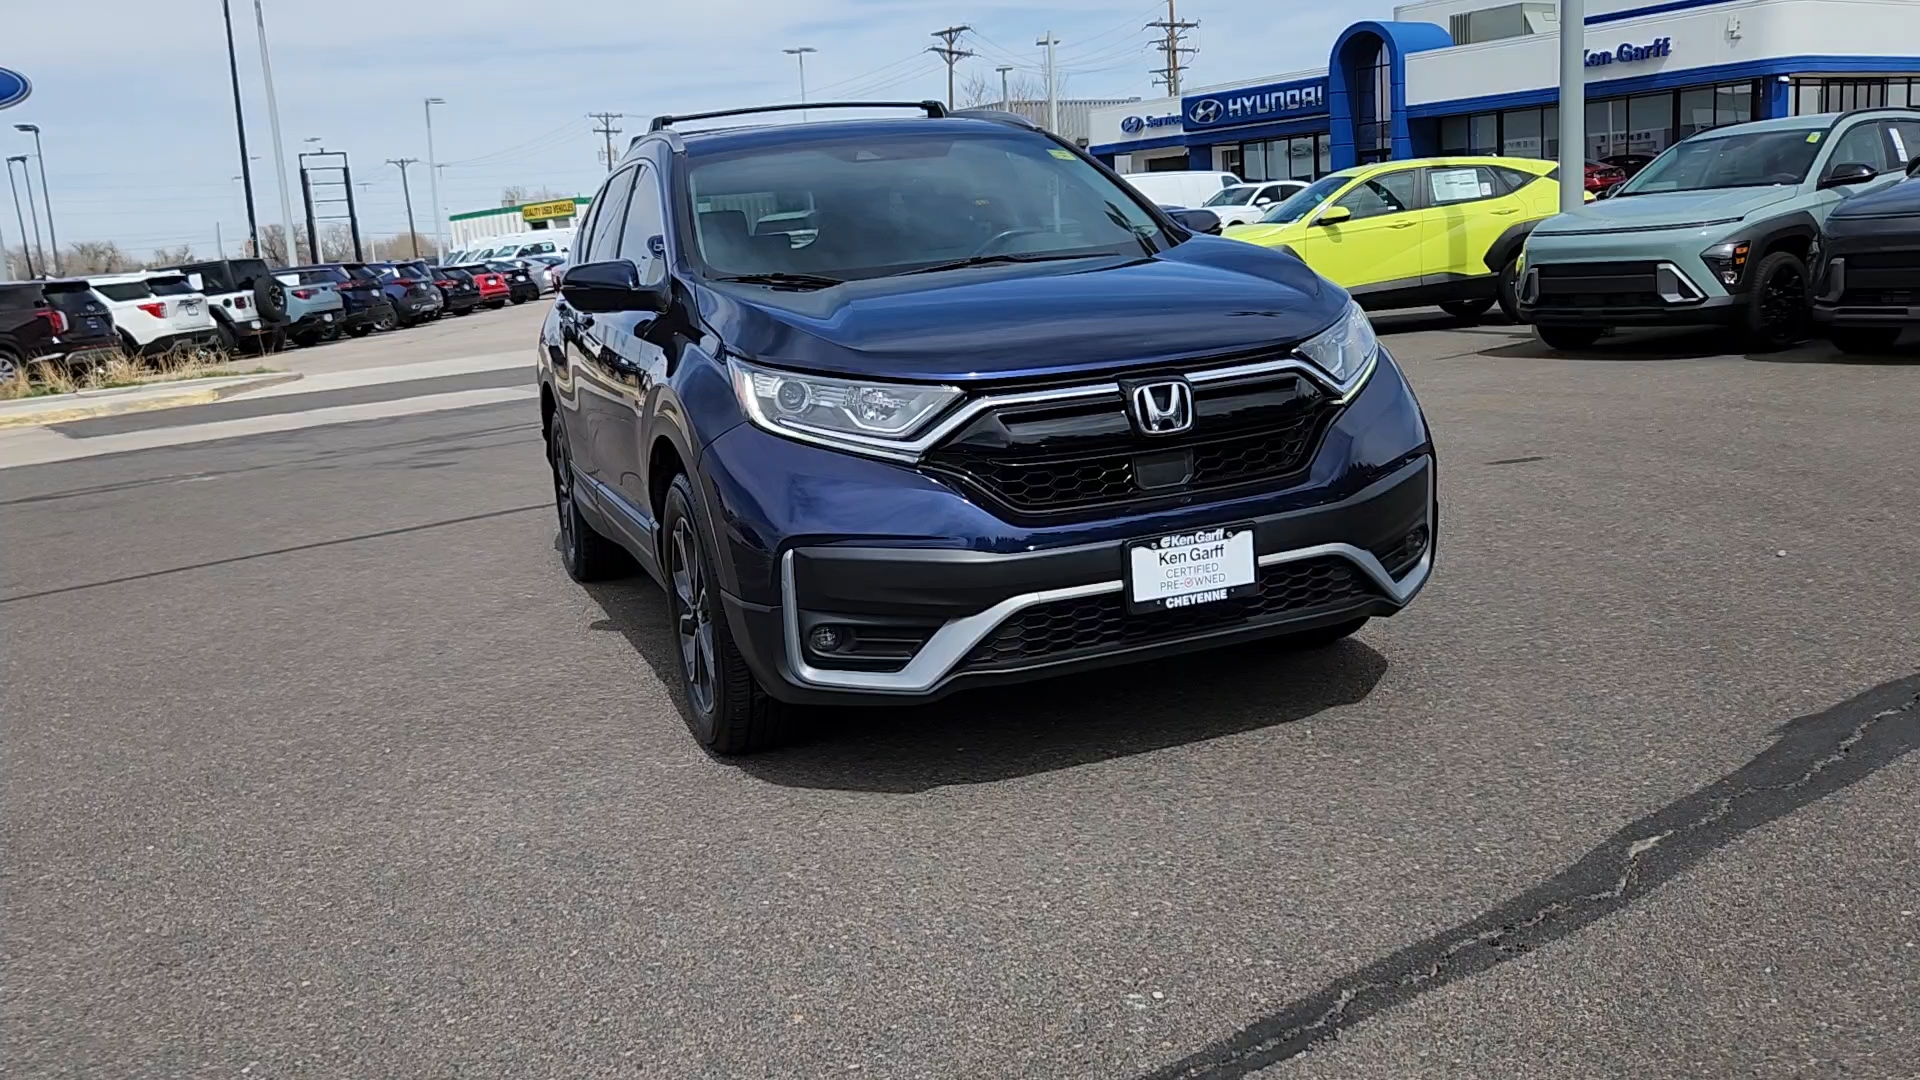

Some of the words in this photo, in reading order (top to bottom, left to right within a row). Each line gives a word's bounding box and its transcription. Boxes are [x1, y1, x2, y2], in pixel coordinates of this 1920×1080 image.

[1616, 37, 1671, 62] Garff
[1228, 85, 1323, 118] HYUNDAI
[1170, 533, 1195, 547] Ken
[1195, 528, 1225, 544] Garff
[1158, 550, 1187, 566] Ken
[1190, 544, 1225, 561] Garff
[1165, 562, 1219, 579] CERTIFIED
[1165, 588, 1228, 609] CHEYENNE
